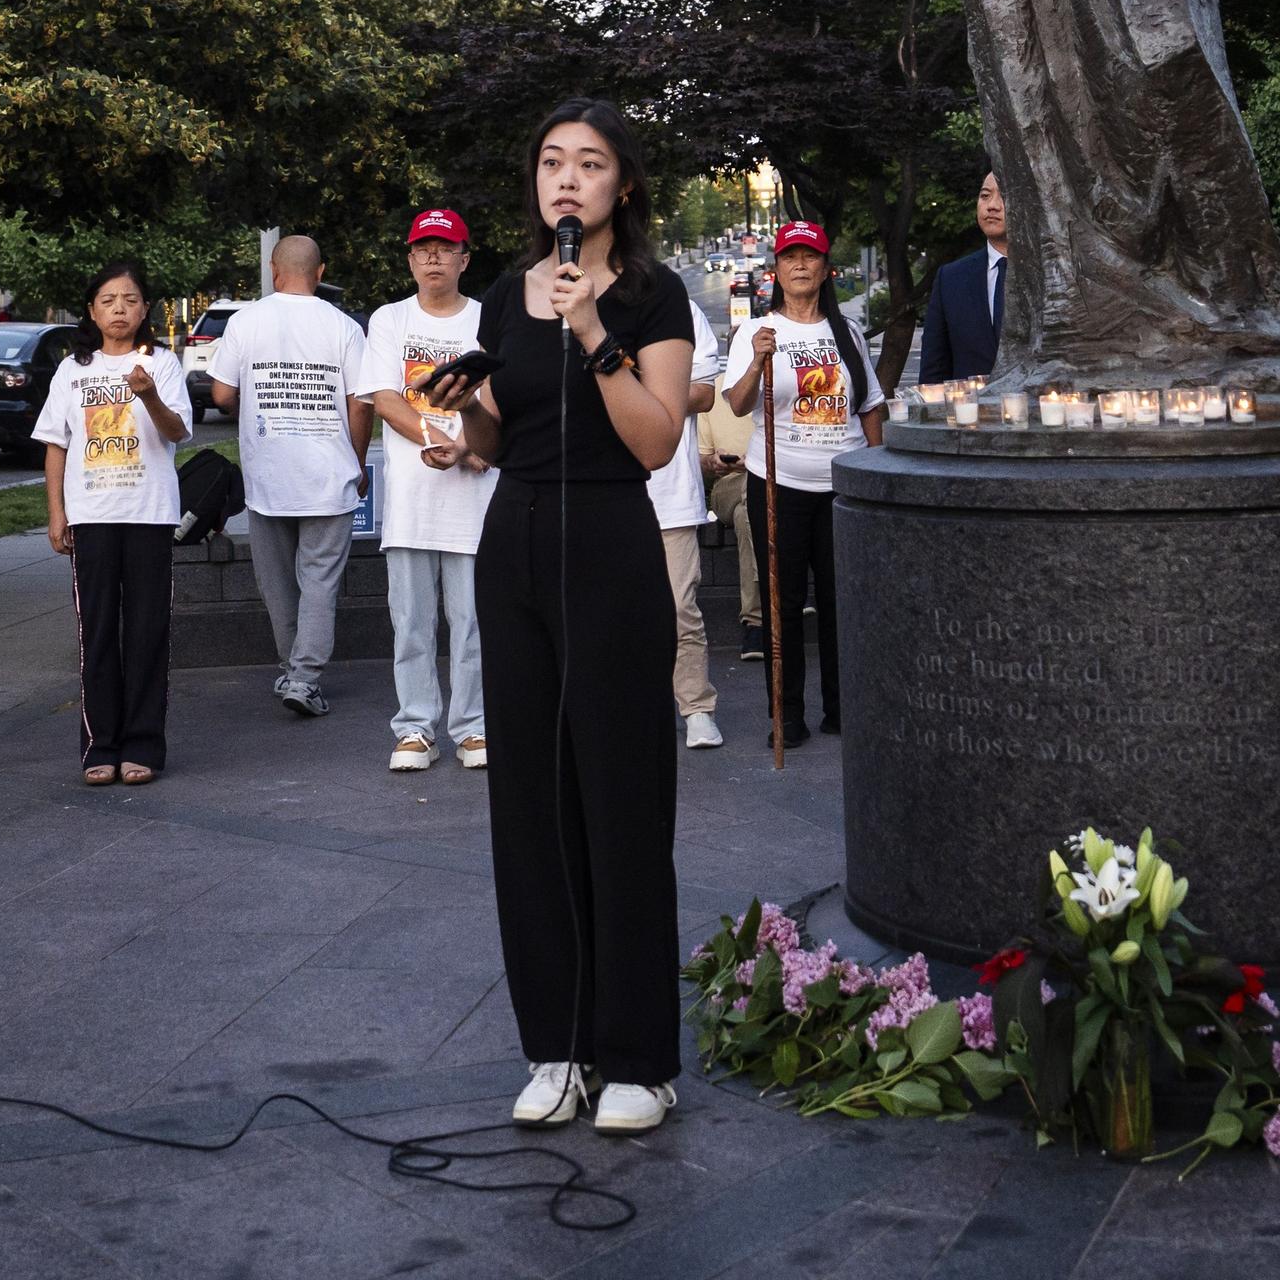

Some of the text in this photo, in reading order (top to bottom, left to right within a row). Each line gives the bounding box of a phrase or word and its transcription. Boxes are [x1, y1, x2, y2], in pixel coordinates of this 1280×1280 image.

[252, 361, 341, 374] ABOLISH CHINESE COMMUNIST
[788, 348, 841, 369] END
[282, 372, 300, 380] PARTY
[301, 373, 325, 381] SYSTEM
[81, 384, 138, 407] END
[257, 392, 284, 400] REPUBLIC
[285, 392, 300, 400] WITH
[259, 401, 337, 411] HUMAN RIGHTS NEW CHINA
[794, 395, 848, 416] CCP
[85, 436, 140, 461] CCP
[975, 612, 1024, 642] the
[1037, 622, 1120, 646] more
[915, 652, 959, 676] one
[970, 649, 1102, 684] hundred
[946, 724, 1024, 759] those
[1037, 734, 1104, 764] who
[1120, 736, 1194, 766] love
